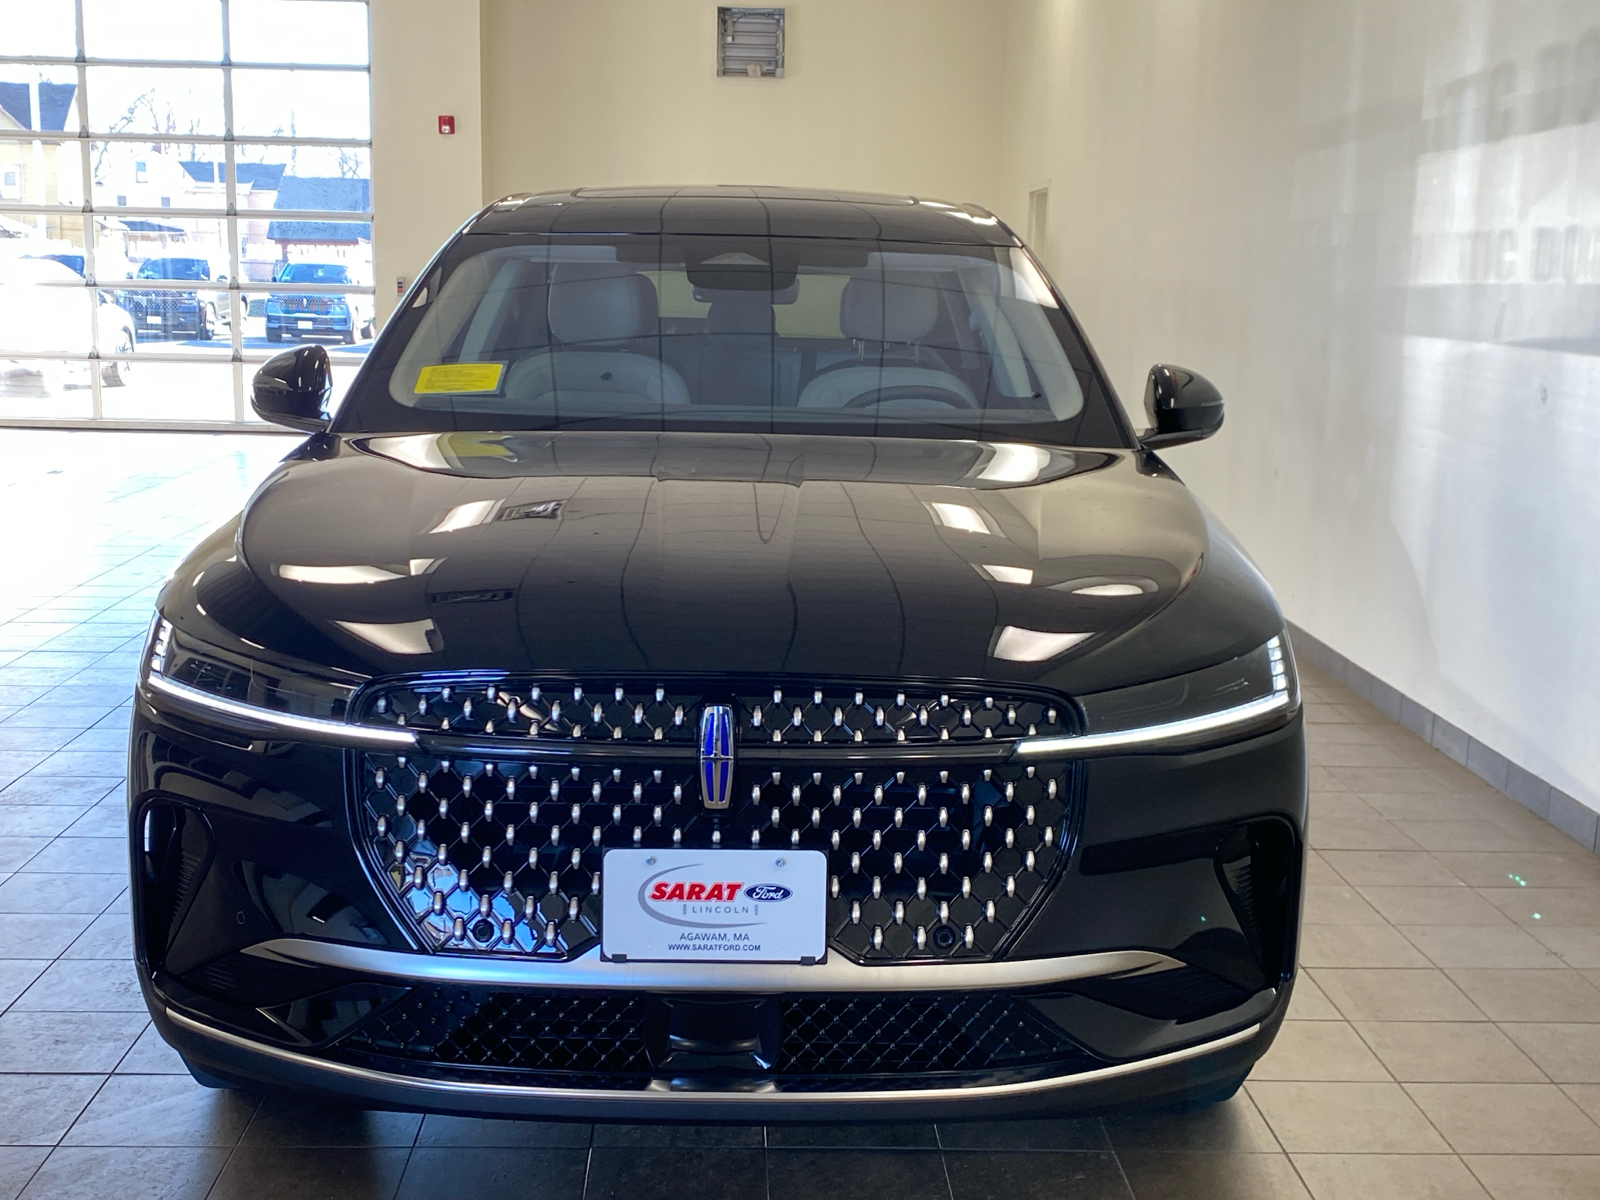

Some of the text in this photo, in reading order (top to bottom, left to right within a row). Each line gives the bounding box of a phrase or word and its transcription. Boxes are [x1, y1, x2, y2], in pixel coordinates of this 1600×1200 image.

[650, 881, 784, 902] SARAT Ford
[692, 905, 749, 914] LINCOLN
[679, 932, 750, 943] AGAWAM, MA
[668, 943, 761, 952] WWW.SARATFORD.COM
